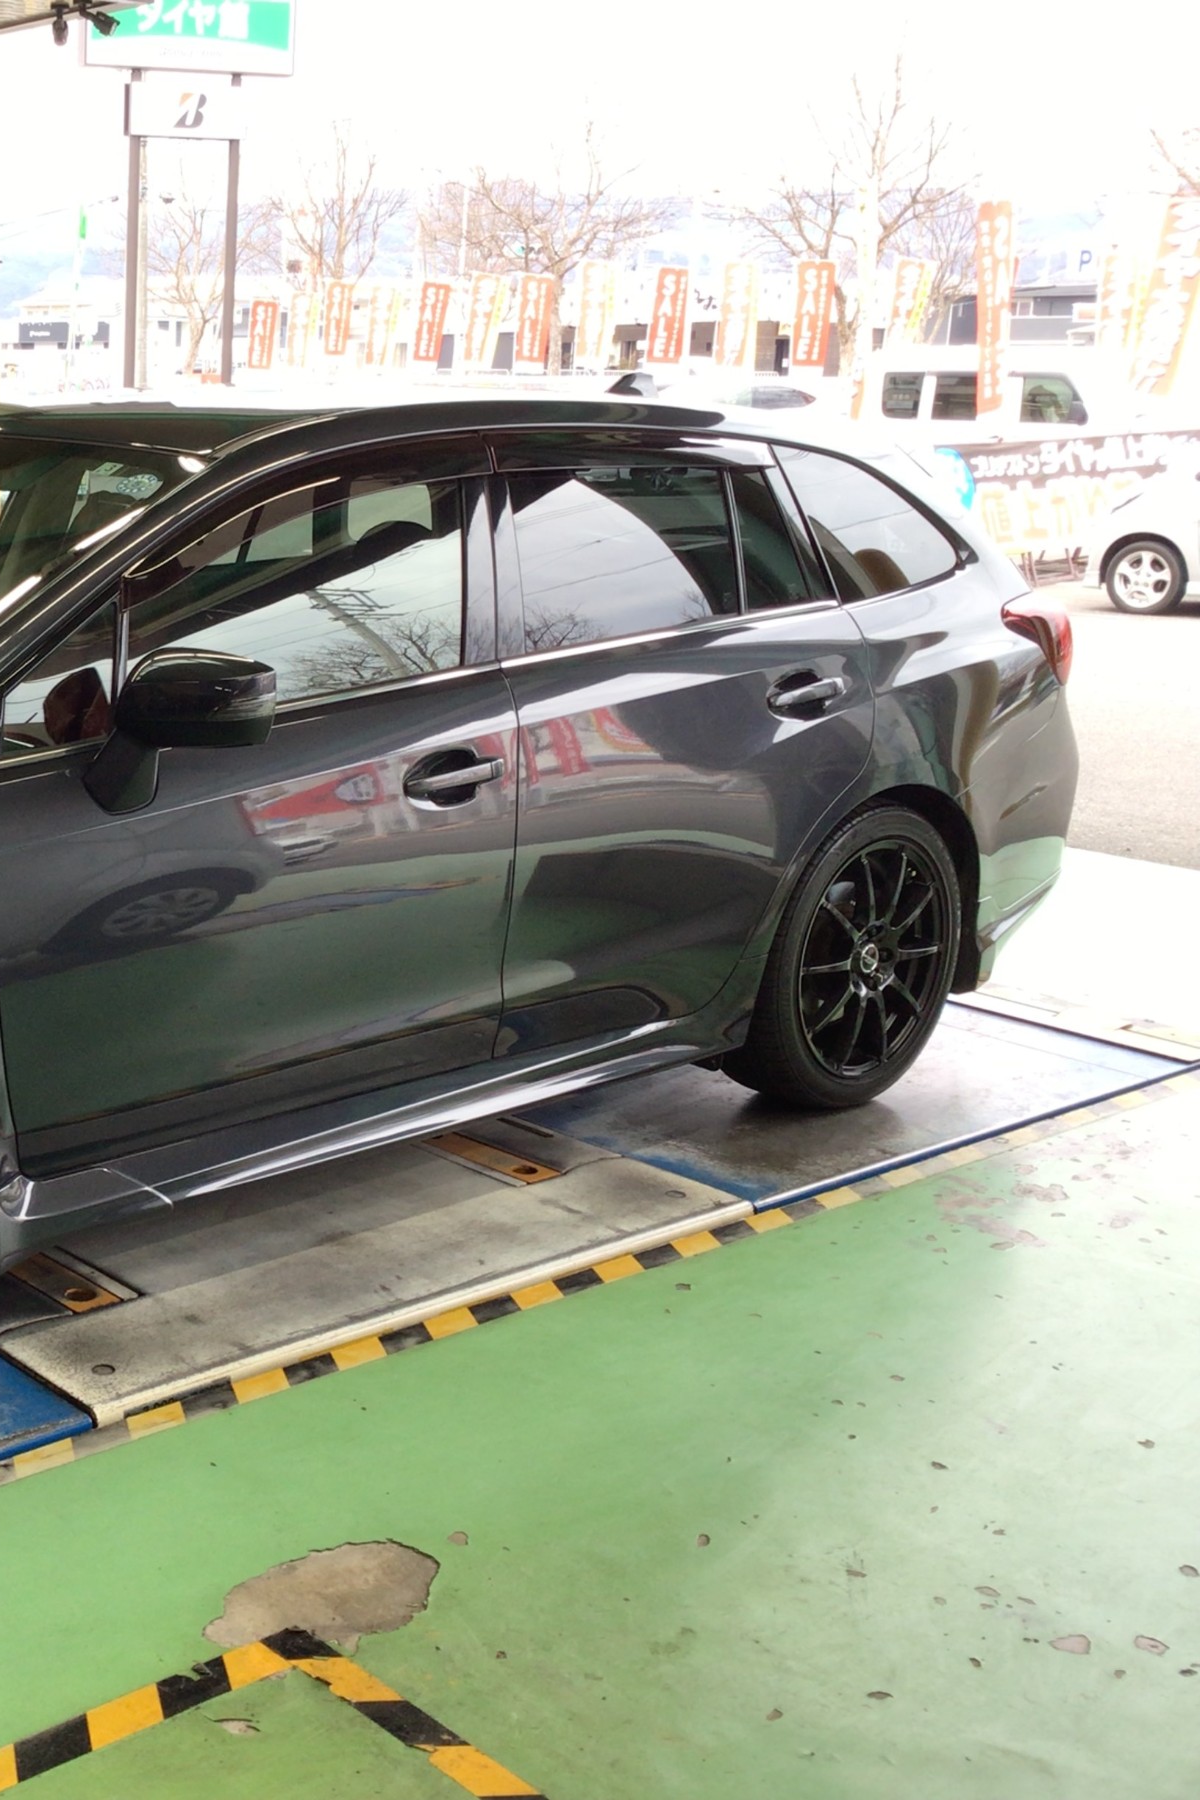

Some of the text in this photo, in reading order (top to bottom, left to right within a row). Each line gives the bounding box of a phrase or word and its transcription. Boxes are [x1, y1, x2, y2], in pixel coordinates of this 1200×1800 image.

[1078, 250, 1093, 272] P
[418, 287, 437, 357] SALE
[523, 280, 539, 357] SALE
[653, 274, 676, 357] SALE
[795, 268, 818, 360] SALE
